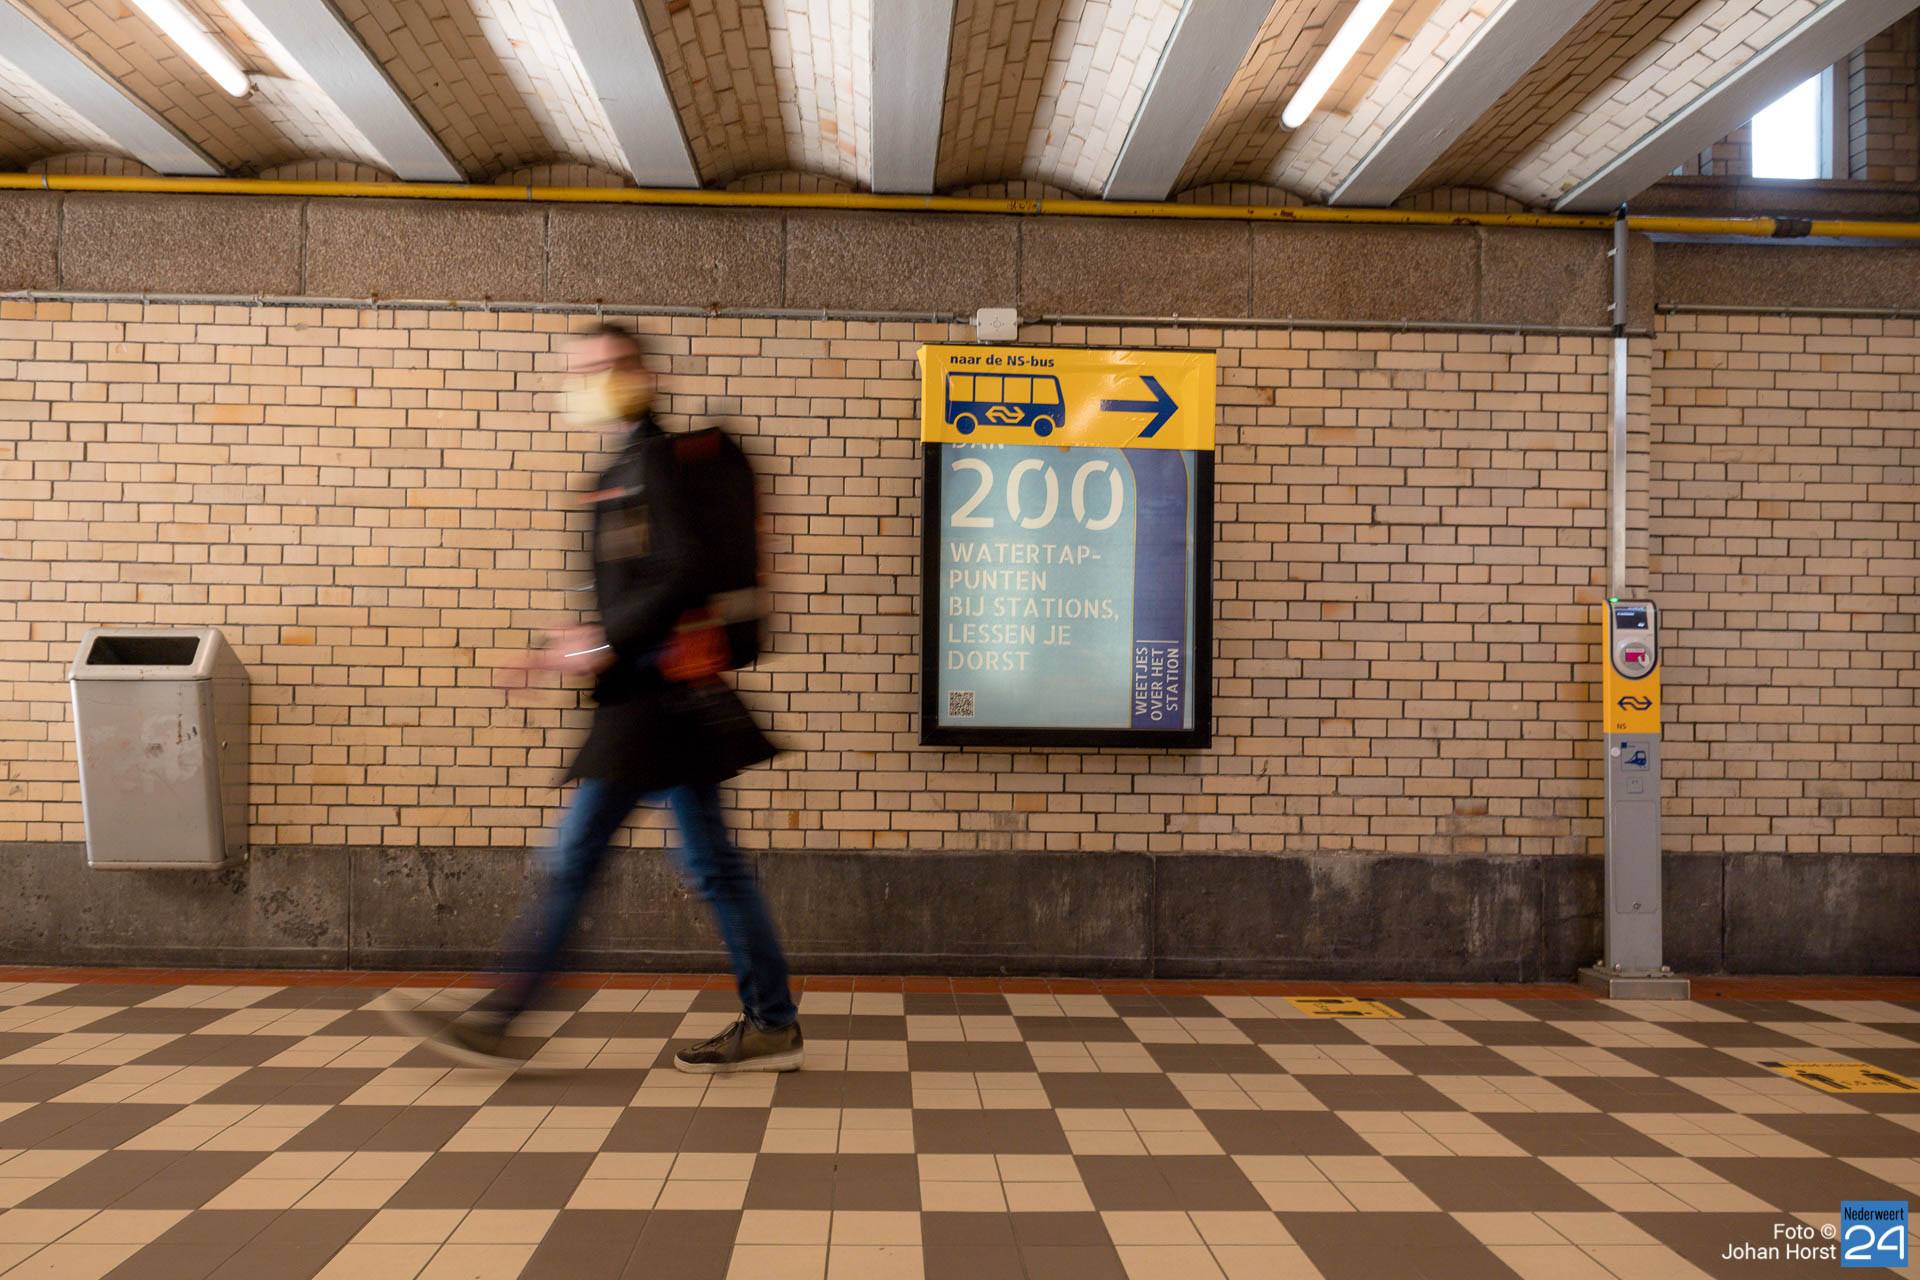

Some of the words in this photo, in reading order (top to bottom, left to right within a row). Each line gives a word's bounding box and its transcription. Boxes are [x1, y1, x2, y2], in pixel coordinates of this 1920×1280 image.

[950, 354, 980, 365] naar
[985, 354, 1003, 366] de
[1007, 355, 1055, 368] NS-bus
[950, 458, 1124, 530] 200
[950, 542, 1101, 565] WATERTAP-
[949, 569, 1047, 591] PUNTEN
[949, 596, 985, 617] BIJ
[993, 597, 1119, 622] STATIONS,
[949, 623, 1035, 645] LESSEN
[1043, 624, 1072, 646] JE
[948, 650, 1030, 671] DORST
[1151, 648, 1164, 677] HET
[1135, 647, 1148, 715] WEETJES
[1166, 648, 1179, 711] STATION
[1150, 681, 1163, 721] OVER
